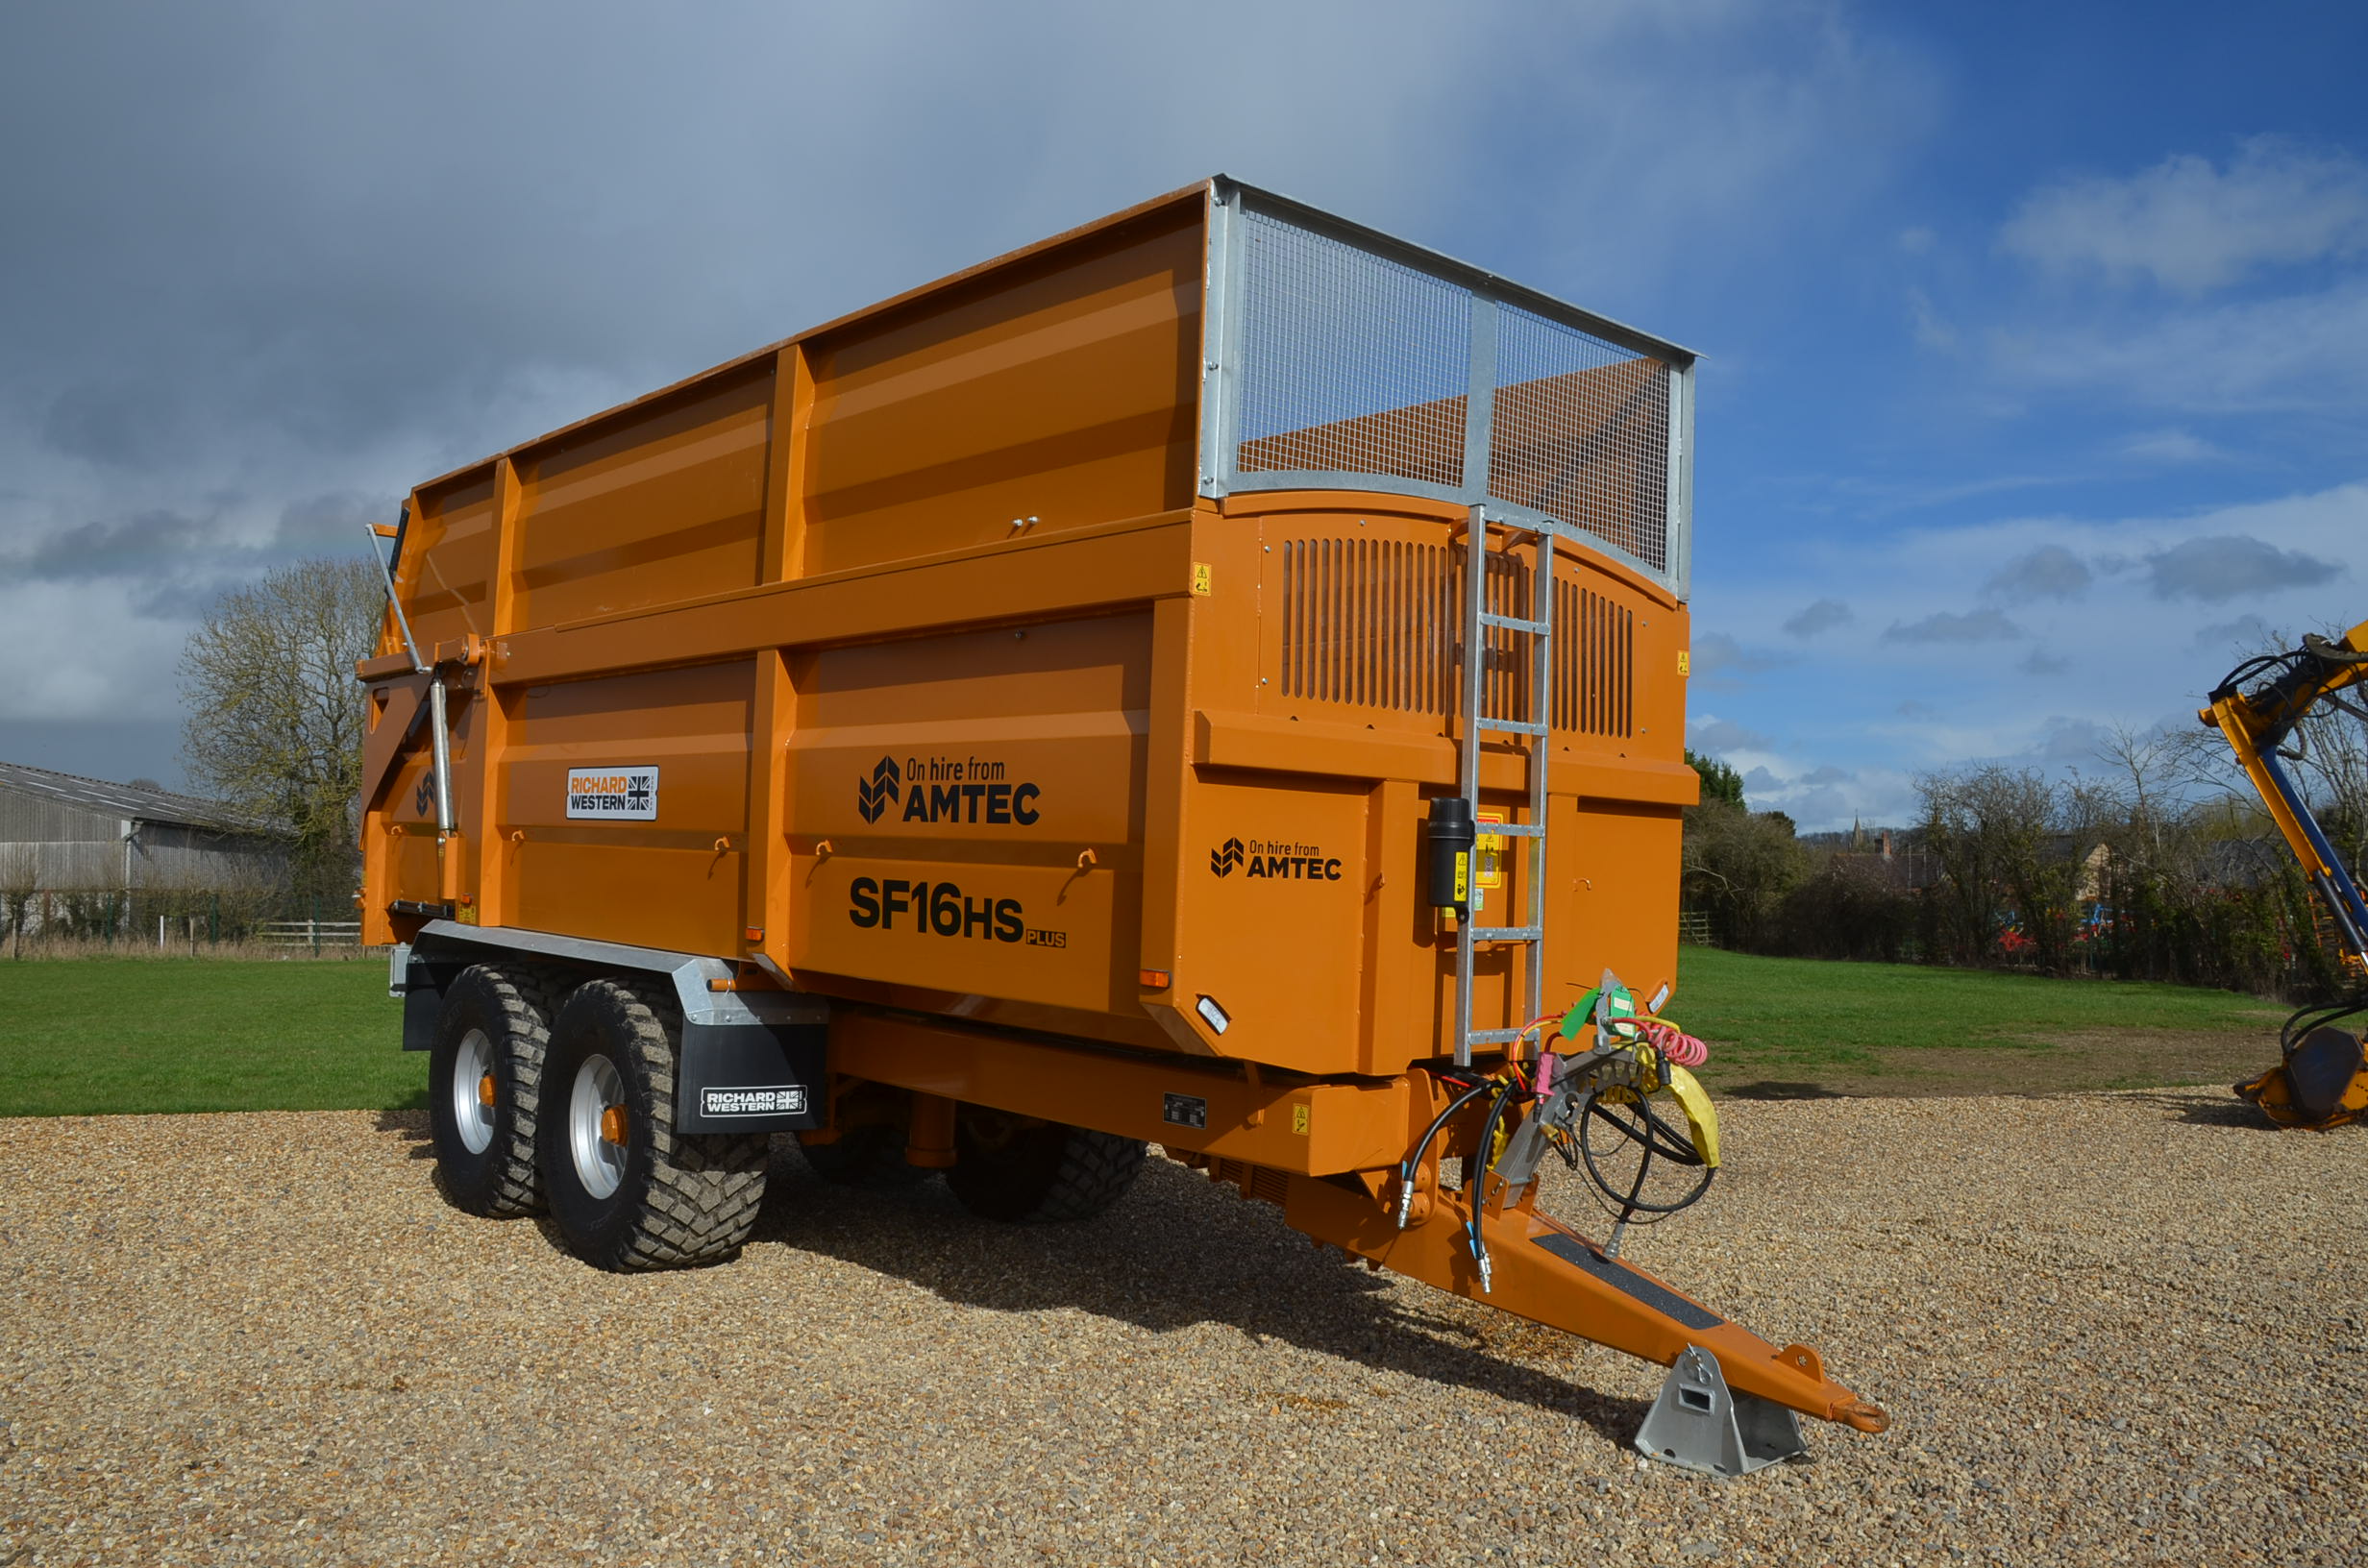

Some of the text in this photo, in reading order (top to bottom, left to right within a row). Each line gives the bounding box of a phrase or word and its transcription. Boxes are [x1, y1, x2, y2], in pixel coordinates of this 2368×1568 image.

[906, 756, 1005, 781] On hire from
[571, 776, 628, 794] RICHARD
[570, 795, 626, 810] WESTERN
[902, 782, 1041, 825] AMTEC
[1249, 840, 1320, 857] On hire from
[1246, 856, 1342, 881] AMTEC
[1025, 928, 1066, 948] PLUS
[707, 1092, 775, 1103] RICHARD
[707, 1102, 775, 1113] WESTERN
